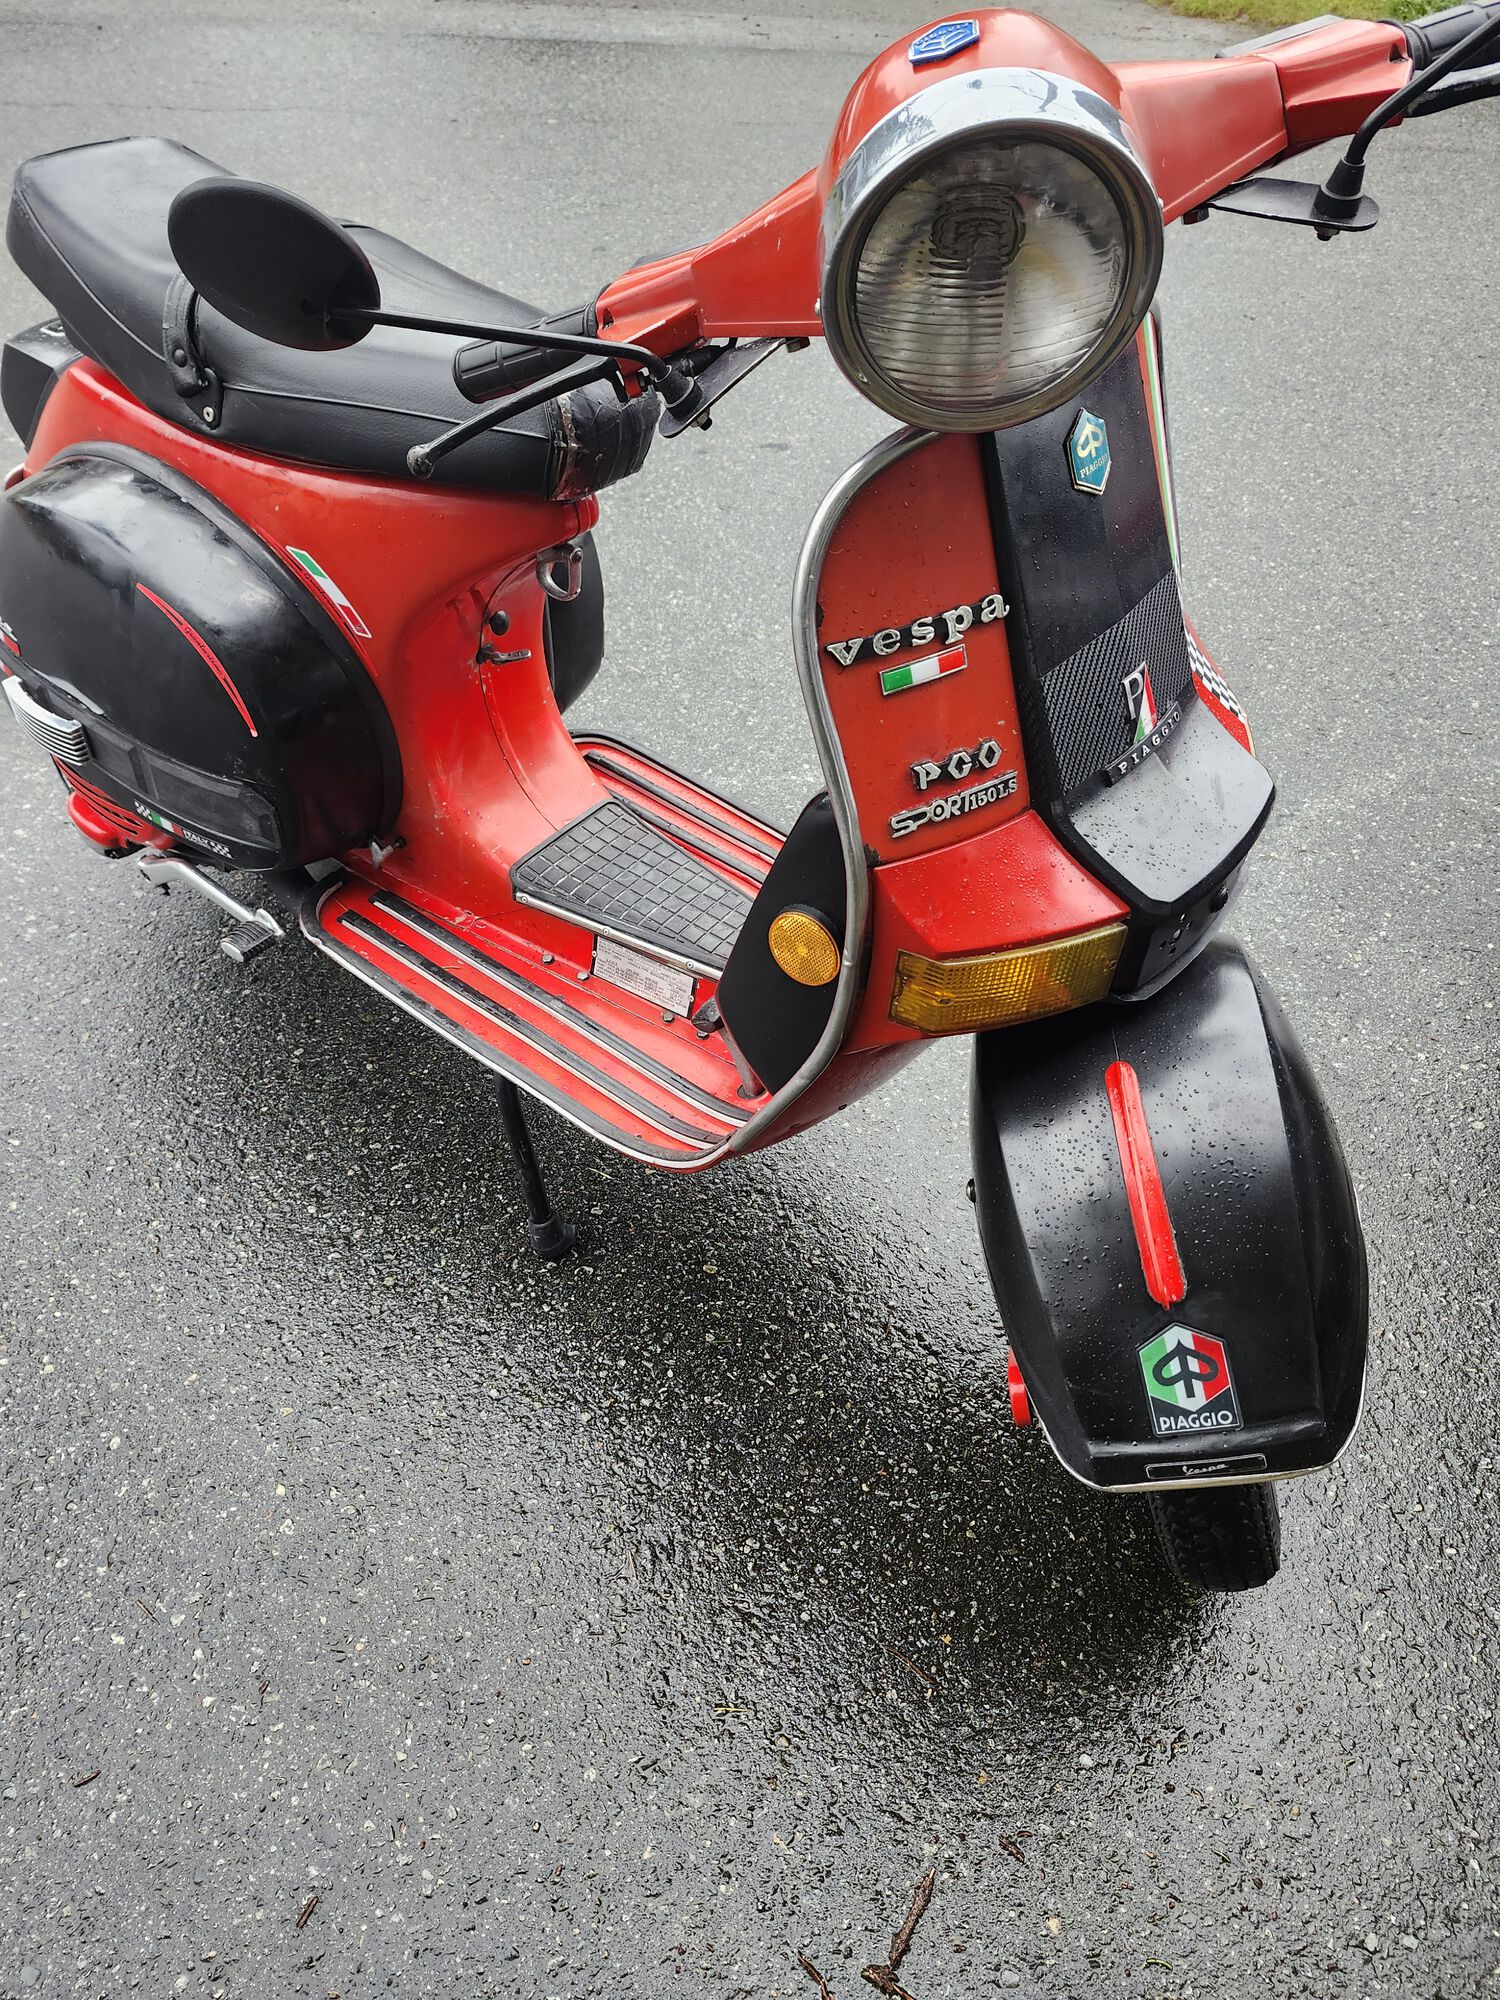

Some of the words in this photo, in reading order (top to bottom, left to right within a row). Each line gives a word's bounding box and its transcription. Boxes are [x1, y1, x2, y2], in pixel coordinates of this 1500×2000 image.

[827, 593, 1010, 666] vespa
[1118, 711, 1180, 775] PIAGGIO
[912, 740, 1002, 790] PGO
[183, 829, 209, 846] ITALY
[1159, 1410, 1233, 1431] PIAGGIO
[1182, 1463, 1229, 1476] Vespa
